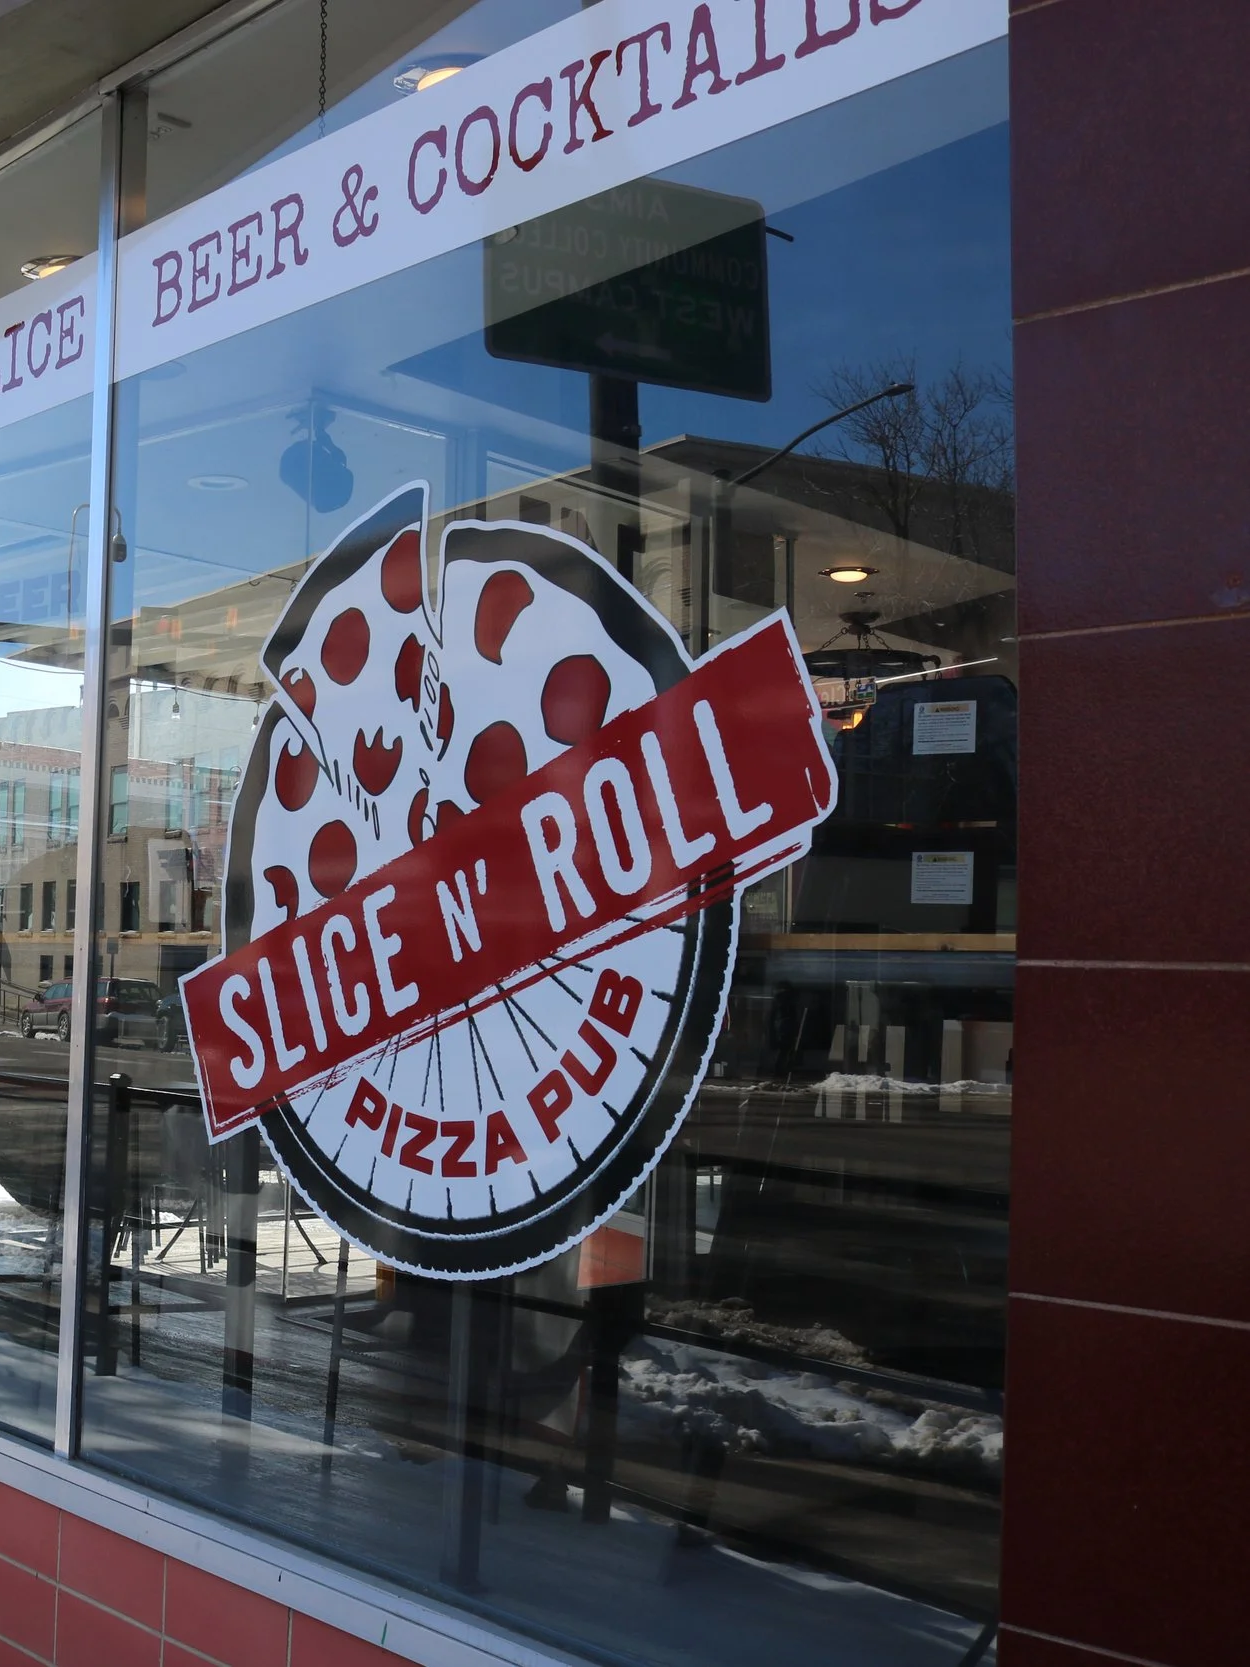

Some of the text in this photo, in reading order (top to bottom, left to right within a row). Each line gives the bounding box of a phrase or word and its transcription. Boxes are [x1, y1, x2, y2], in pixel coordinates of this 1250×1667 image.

[152, 193, 309, 328] BEER
[332, 163, 379, 247] &
[218, 698, 773, 1090] SLICE N' ROLL
[344, 968, 644, 1178] PIZZA PUB
